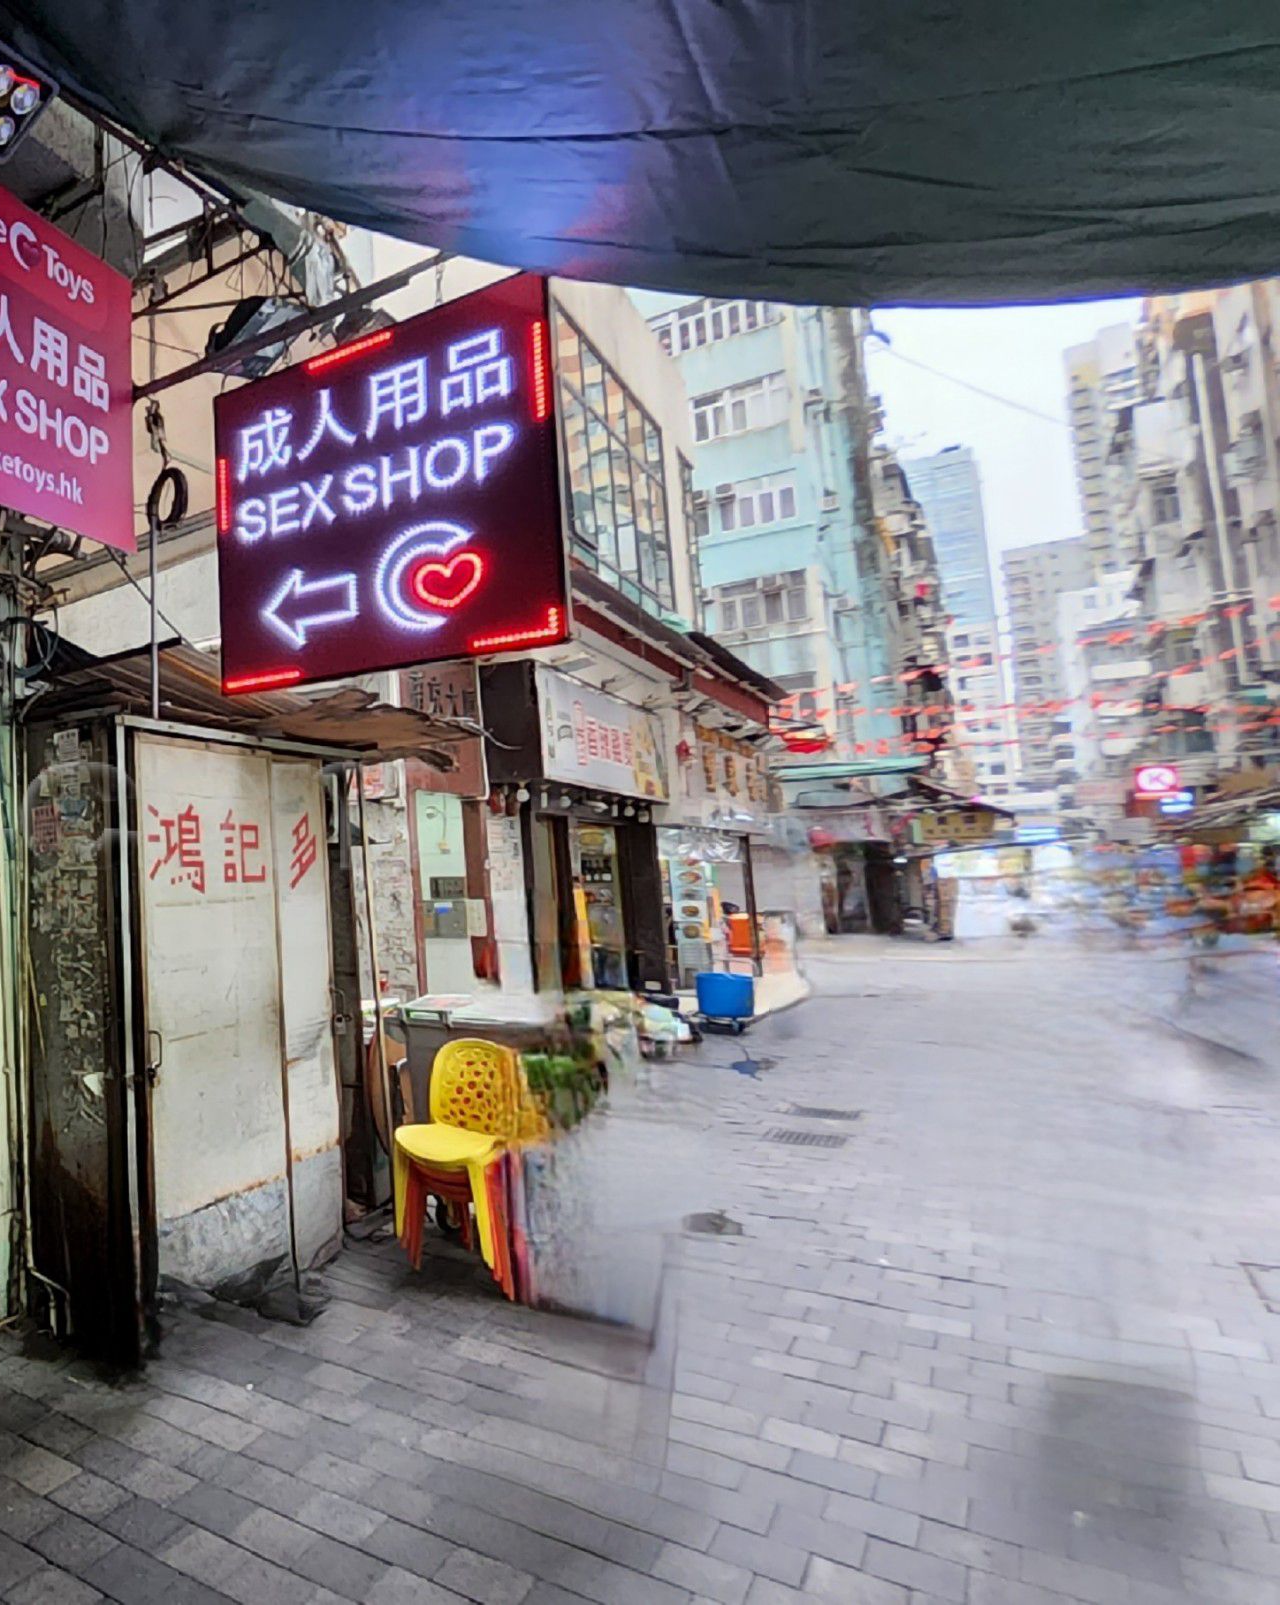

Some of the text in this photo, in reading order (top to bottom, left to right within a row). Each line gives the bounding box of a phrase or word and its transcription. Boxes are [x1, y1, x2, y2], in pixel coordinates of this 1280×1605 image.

[41, 243, 96, 304] Toys
[14, 389, 110, 465] SHOP
[236, 327, 512, 484] 成人用品
[234, 421, 516, 546] SEX SHOP
